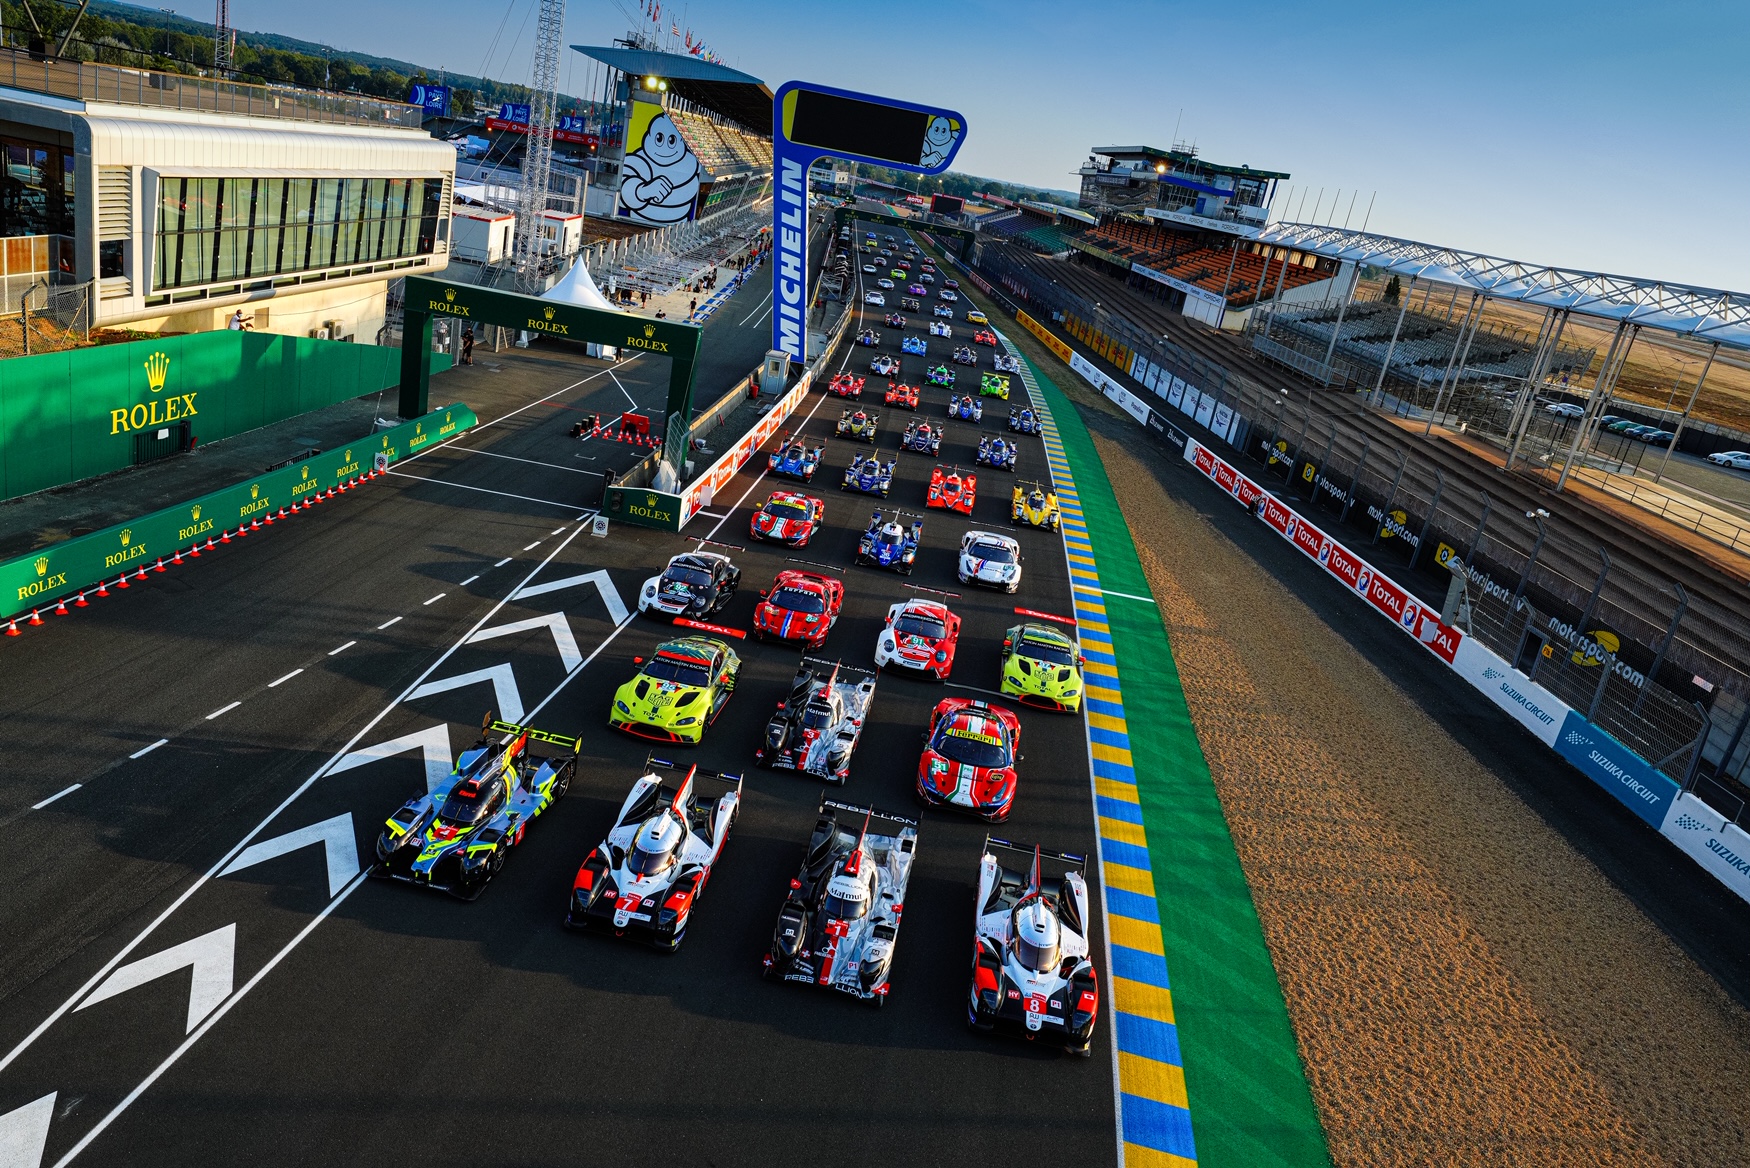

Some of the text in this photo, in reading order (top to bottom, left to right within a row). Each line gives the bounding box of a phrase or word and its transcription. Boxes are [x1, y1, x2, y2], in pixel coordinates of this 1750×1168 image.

[780, 157, 802, 357] MICHELIN
[429, 300, 470, 317] ROLEX
[528, 318, 569, 335] ROLEX
[627, 336, 669, 353] ROLEX
[110, 392, 198, 435] ROLEX
[439, 422, 456, 435] ROLEX
[409, 434, 427, 447] ROLEX
[1198, 451, 1211, 470] TOTAL
[336, 461, 359, 478] ROLEX
[1218, 466, 1233, 487] TOTAL
[292, 478, 317, 497] ROLEX
[240, 497, 270, 517] ROLEX
[629, 505, 671, 522] ROLEX
[1267, 503, 1287, 527] TOTAL
[178, 518, 214, 541] ROLEX
[1297, 525, 1319, 552] TOTAL
[104, 543, 147, 568] ROLEX
[672, 562, 712, 574] PORSCHE
[1331, 550, 1357, 580] TOTAL
[17, 572, 67, 601] ROLEX
[676, 584, 687, 592] 92
[784, 586, 817, 597] Ferrari
[1372, 579, 1401, 614] TOTAL
[902, 613, 944, 625] PORSCHE
[1025, 609, 1066, 622] TOTAL
[687, 619, 731, 634] TOTAL
[1421, 614, 1453, 654] TTAL
[913, 637, 923, 645] 91
[655, 656, 709, 671] ASTON MARTIN RACING
[1034, 684, 1052, 692] TOTAL
[652, 693, 672, 701] TAG
[1500, 682, 1555, 726] SUZUKA CIRCUIT
[642, 710, 664, 720] TOTAL
[806, 731, 816, 739] 3
[957, 730, 992, 744] Ferrari
[933, 760, 948, 771] 51
[1588, 749, 1660, 804] SUZUKA CIRCUIT
[824, 800, 918, 826] REBELLION
[1705, 838, 1750, 876] SUZUKA
[604, 890, 617, 898] HY
[829, 887, 862, 900] Matmut
[621, 898, 633, 910] 7
[834, 925, 842, 936] 1
[835, 983, 863, 999] LLION
[1008, 990, 1020, 999] HY
[1029, 999, 1040, 1013] 8
